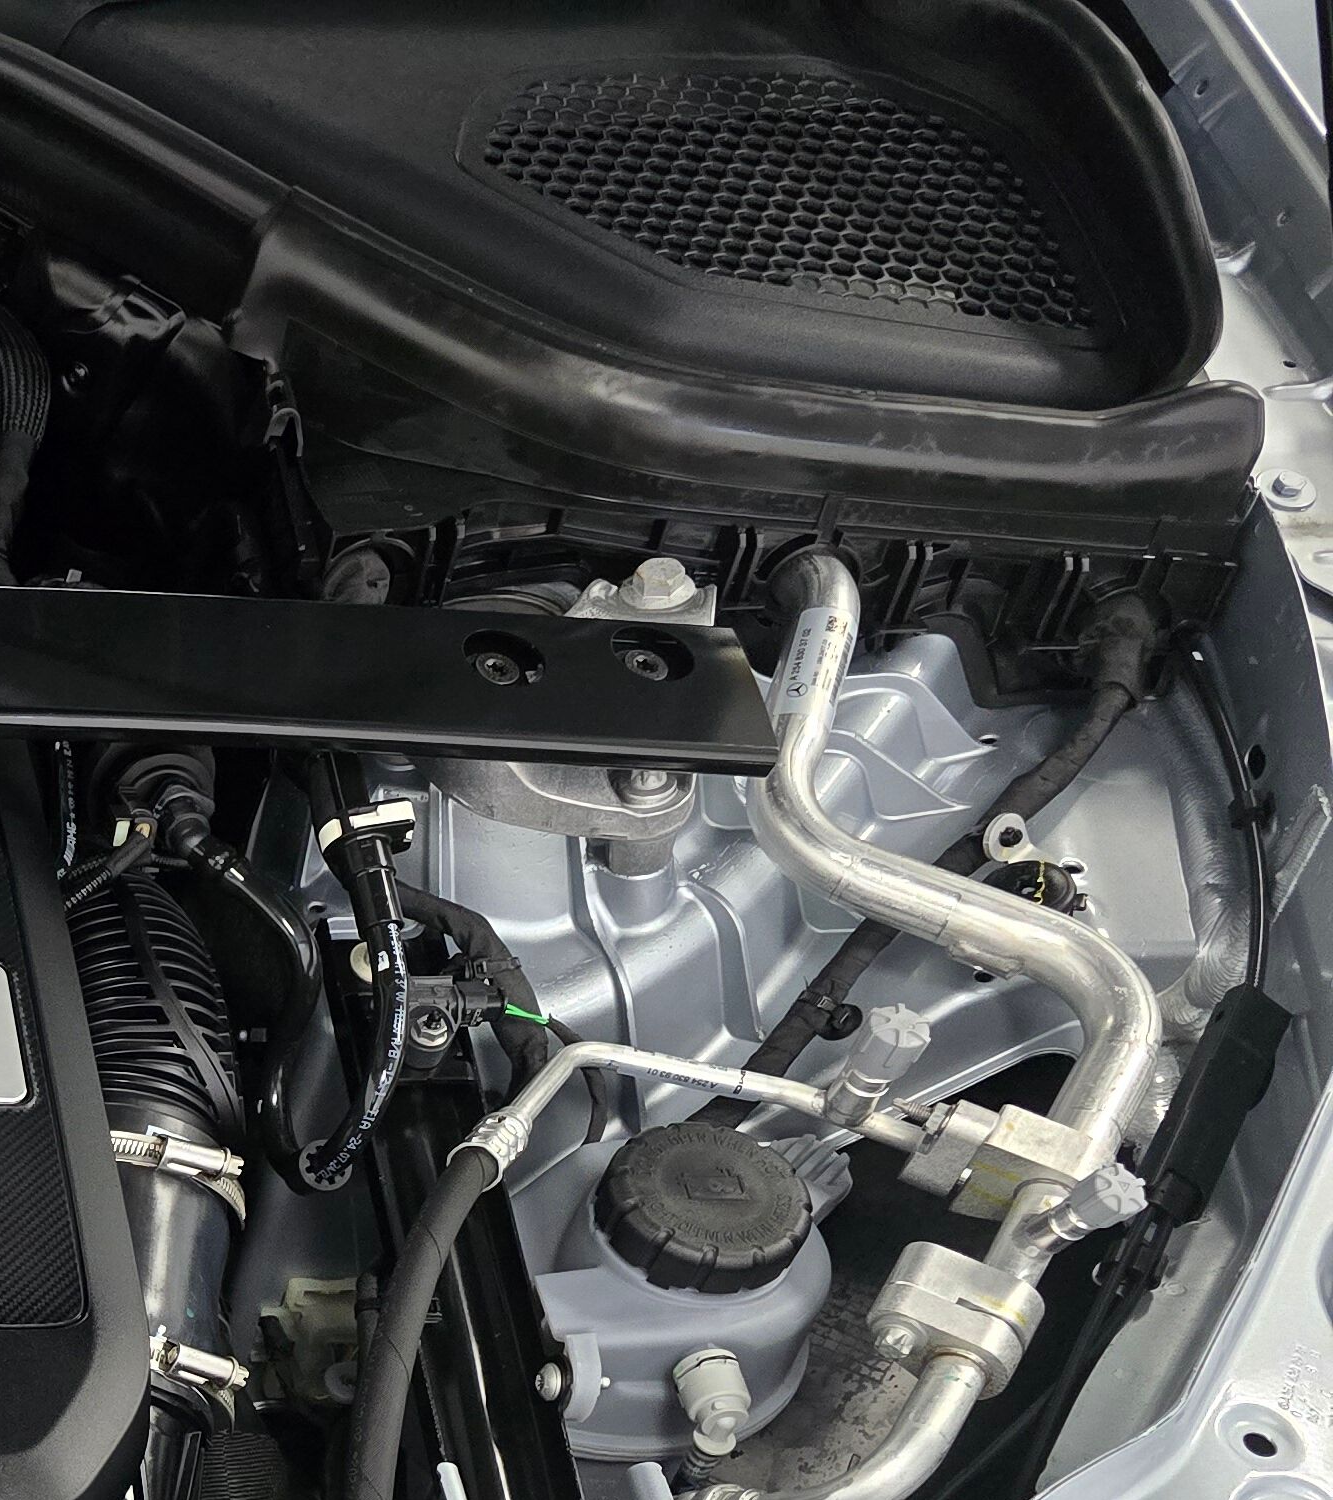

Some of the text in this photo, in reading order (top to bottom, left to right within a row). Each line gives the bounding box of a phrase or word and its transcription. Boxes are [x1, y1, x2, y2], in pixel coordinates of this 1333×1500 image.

[646, 1067, 658, 1077] 01
[659, 1070, 672, 1080] 93
[673, 1073, 690, 1083] 830
[692, 1078, 708, 1088] 254
